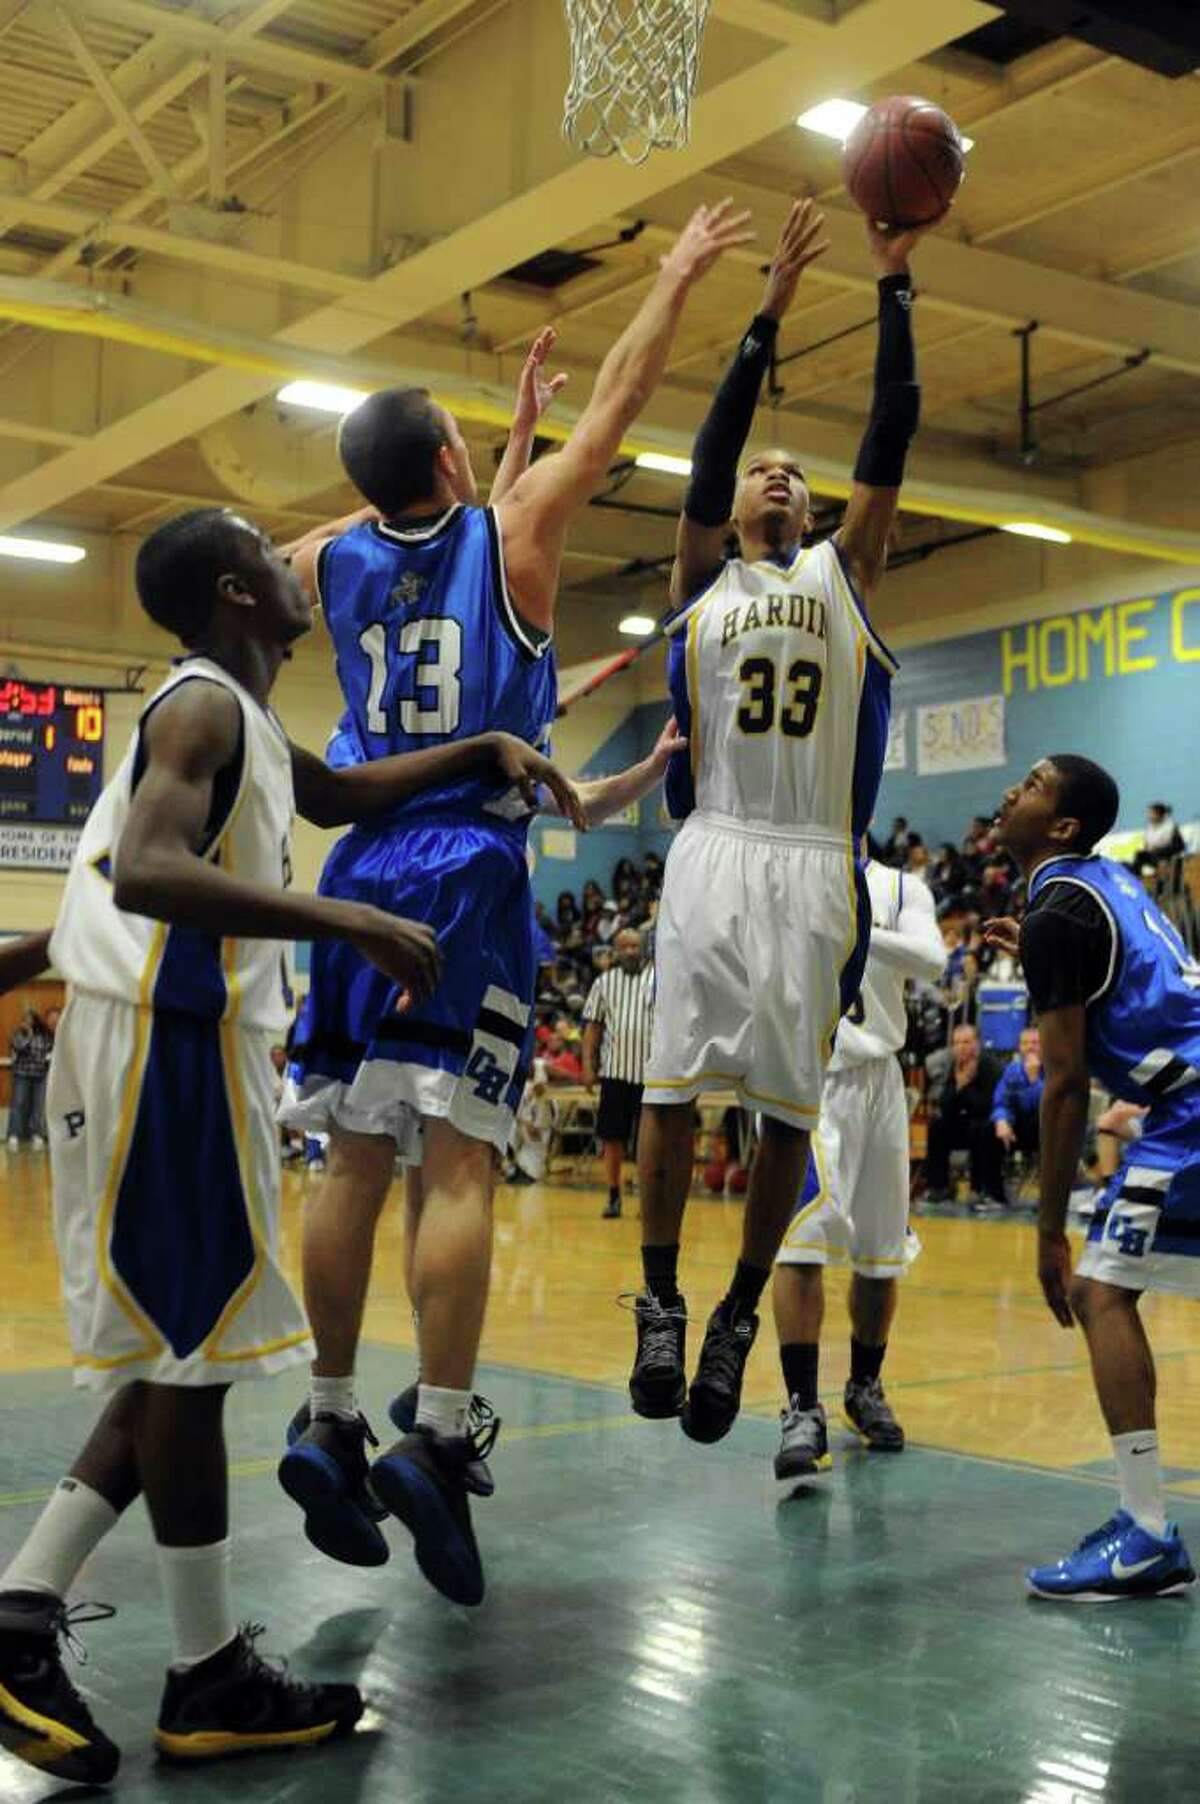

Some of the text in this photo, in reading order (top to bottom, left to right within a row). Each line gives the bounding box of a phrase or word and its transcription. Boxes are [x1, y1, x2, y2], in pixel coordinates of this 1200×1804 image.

[359, 617, 462, 735] 13
[1001, 600, 1157, 696] HOME
[737, 657, 823, 738] 33
[64, 1109, 85, 1138] P
